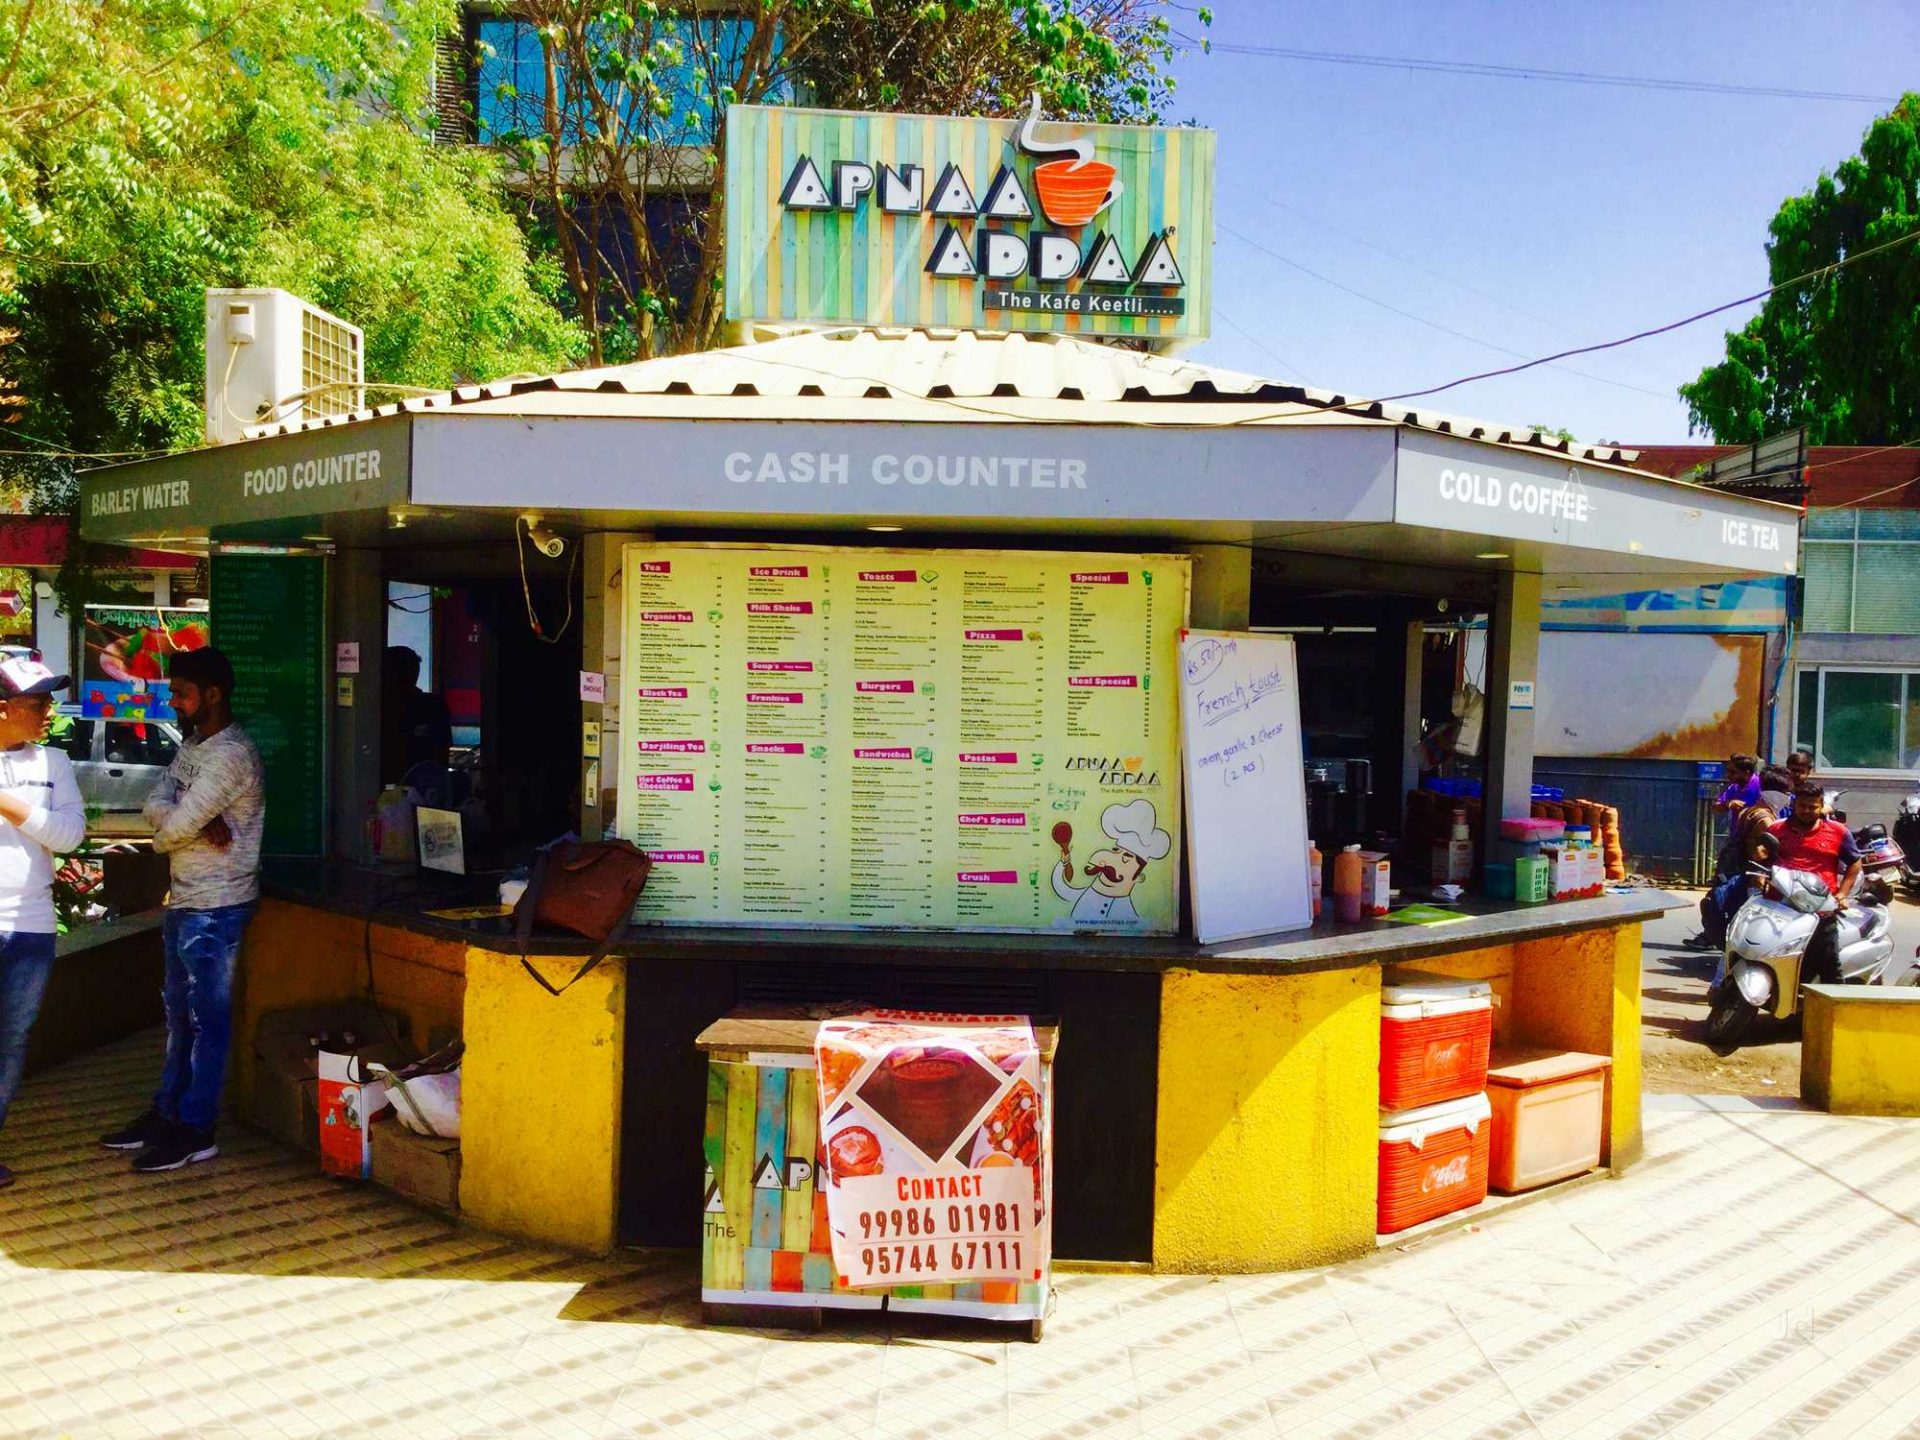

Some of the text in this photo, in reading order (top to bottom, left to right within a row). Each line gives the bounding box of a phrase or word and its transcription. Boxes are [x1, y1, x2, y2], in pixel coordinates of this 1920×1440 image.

[778, 153, 1034, 222] APNAA
[924, 223, 1186, 286] ADDAA
[998, 292, 1031, 308] The
[1039, 293, 1081, 312] Kafe
[243, 449, 382, 497] FOOD COUNTER
[724, 452, 1088, 489] CASH COUNTER
[91, 480, 190, 517] BARLEY WATER
[1439, 469, 1589, 523] COLD COFFEE
[1721, 519, 1780, 551] ICE TEA
[644, 563, 661, 571] Tea
[755, 568, 801, 577] Ice Drink
[862, 572, 896, 581] Toasts
[1075, 574, 1112, 583] Special
[750, 604, 802, 613] Milk Shake
[677, 613, 692, 621] Tea
[861, 681, 902, 691] Burgers
[1070, 677, 1131, 687] Real Special
[642, 689, 683, 698] Black Tea
[1196, 680, 1248, 718] French
[686, 743, 705, 751] Tea
[750, 744, 786, 753] Snacks
[858, 750, 911, 759] Sandwiches
[964, 754, 997, 762] Pastas
[639, 776, 654, 784] Hot
[655, 776, 683, 784] Coffee
[959, 815, 1024, 826] Chef's Special
[666, 852, 685, 860] with
[961, 873, 992, 882] Crush
[897, 1175, 982, 1202] CONTACT
[859, 1202, 1020, 1239] 99986 01981
[703, 1222, 736, 1239] The
[861, 1241, 1021, 1275] 95744 67111
